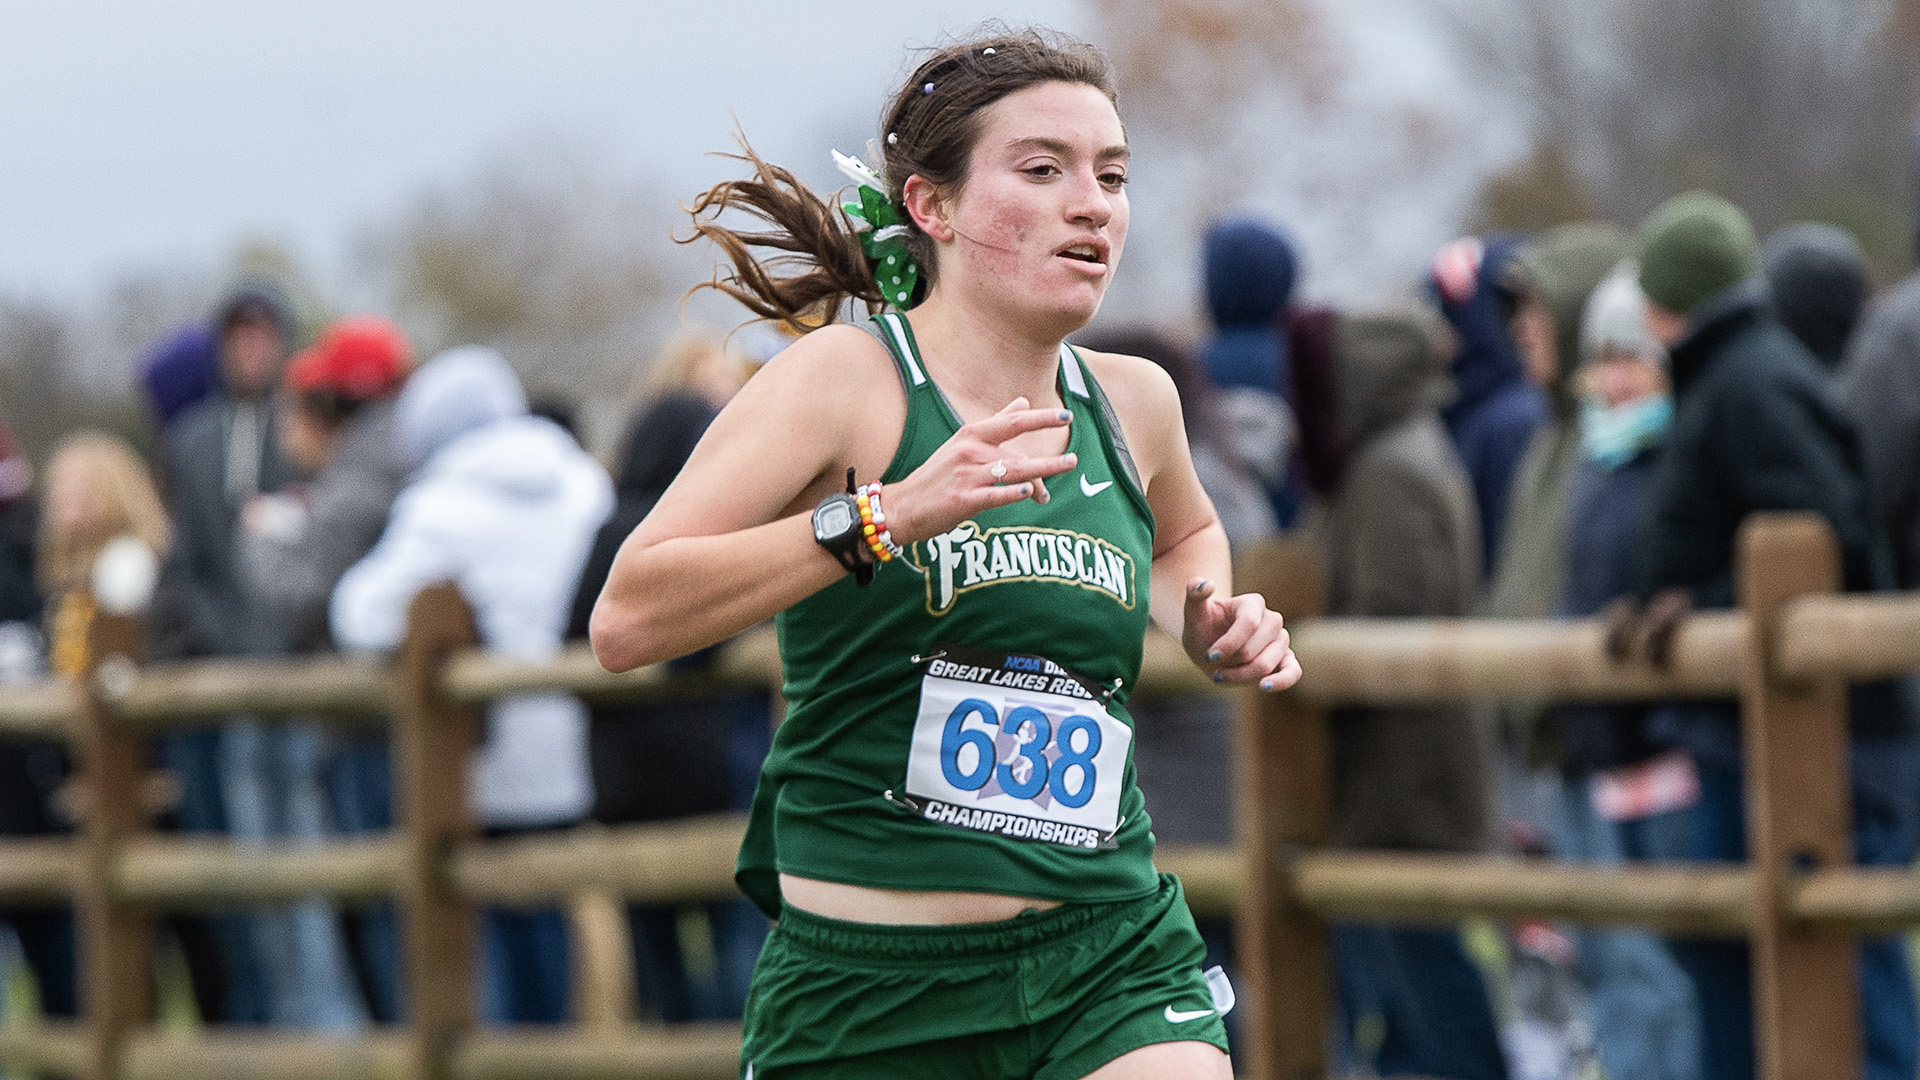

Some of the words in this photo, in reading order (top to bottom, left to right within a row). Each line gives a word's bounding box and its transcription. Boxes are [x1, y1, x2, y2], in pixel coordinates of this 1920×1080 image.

[927, 527, 1127, 609] FRANCISCAN
[929, 659, 991, 682] GREAT
[990, 670, 1049, 691] LAKES
[1004, 656, 1041, 672] NCAA
[940, 698, 1102, 809] 638
[924, 801, 1099, 849] CHAMPIONSHIPS
